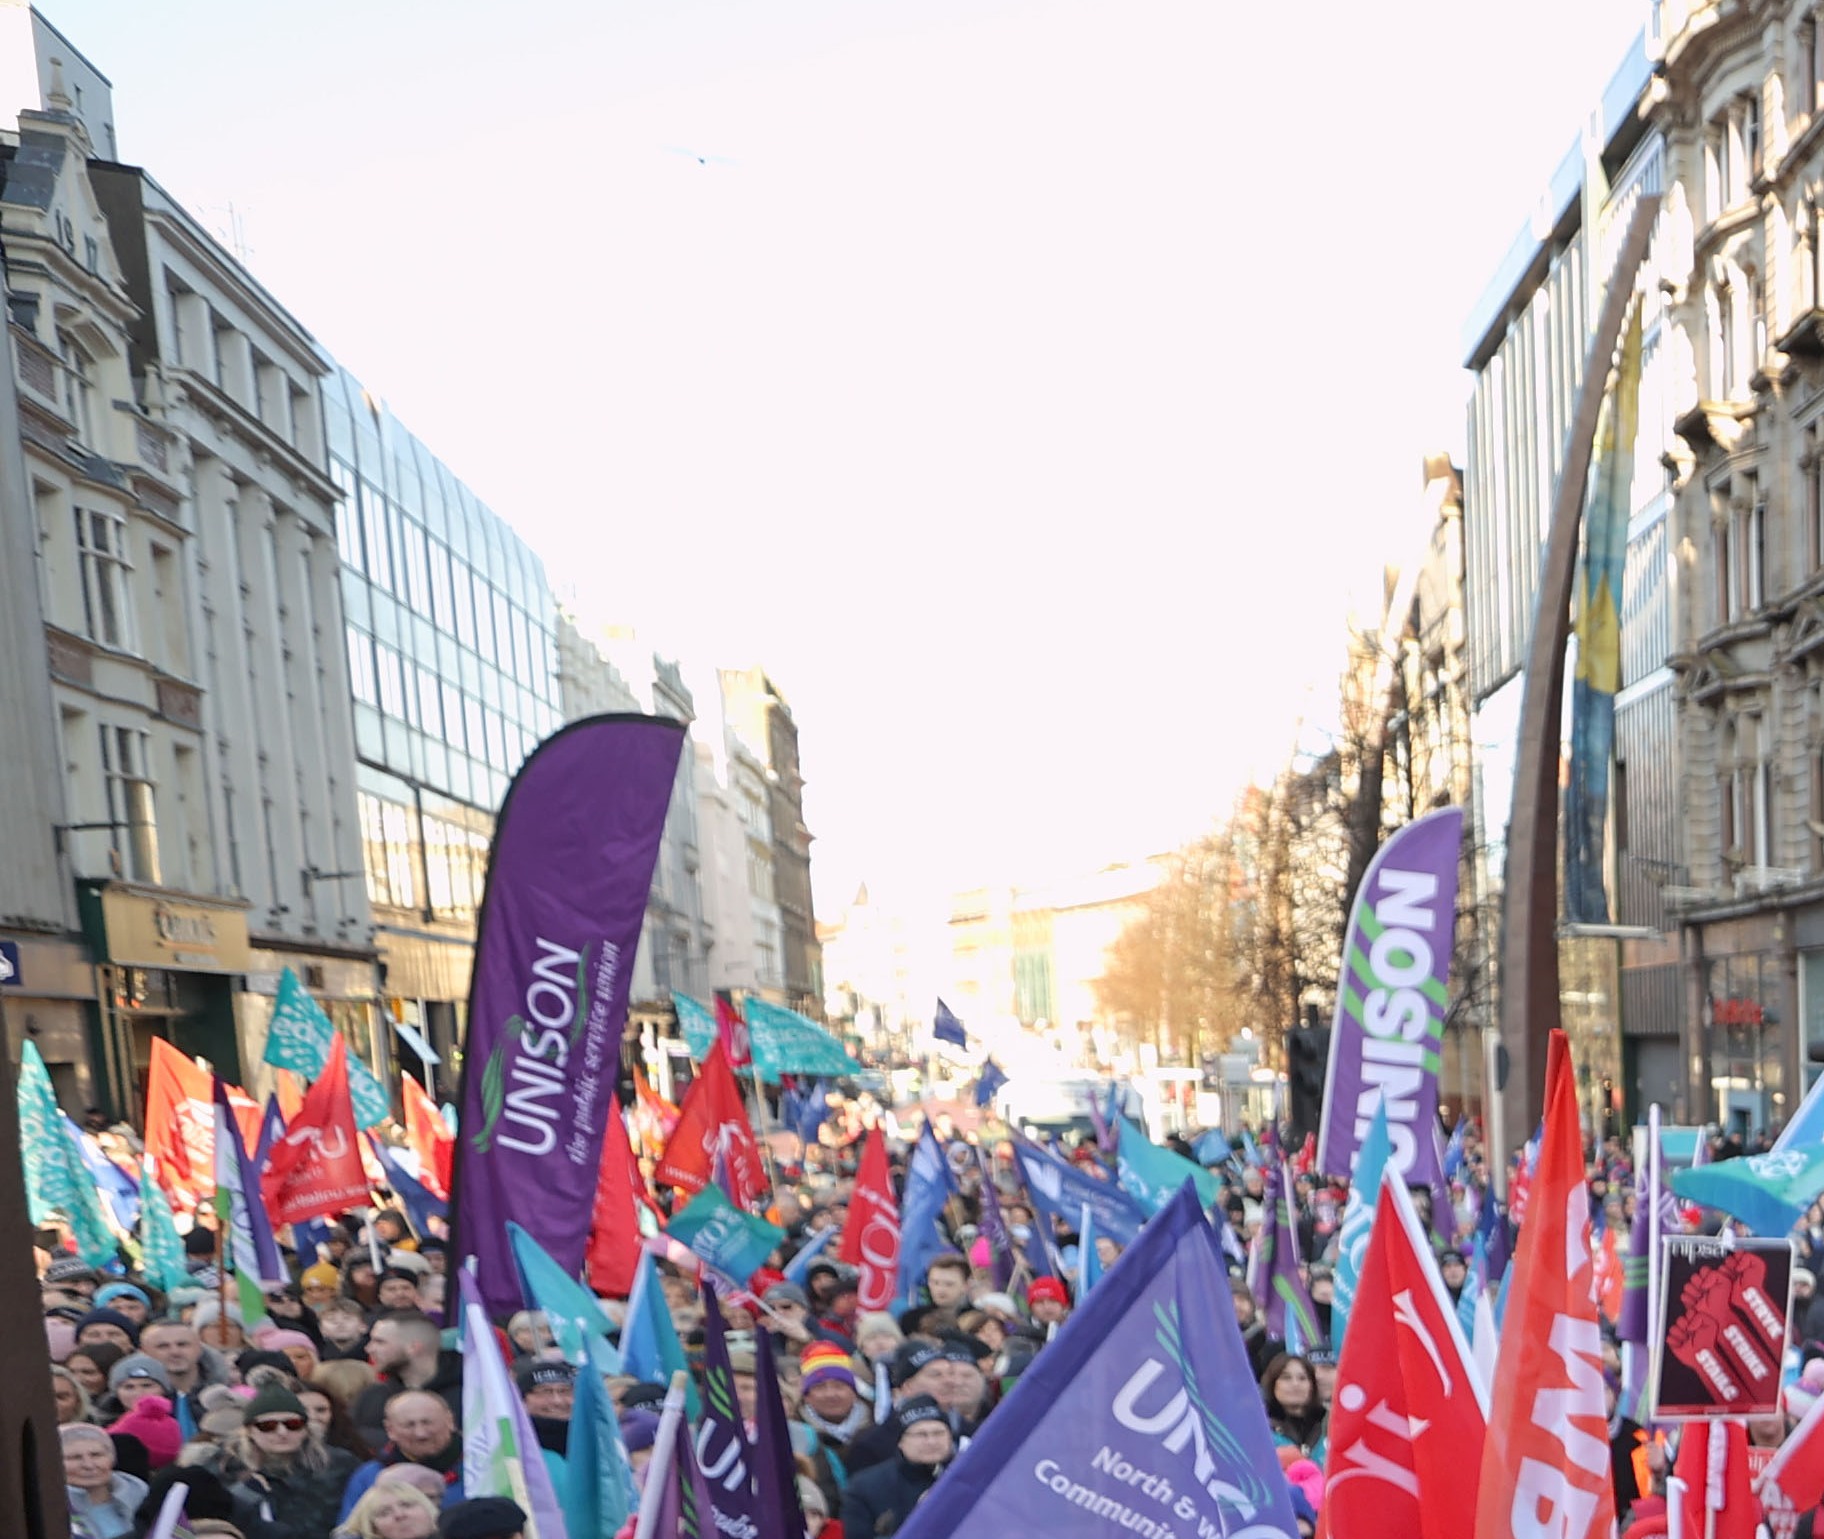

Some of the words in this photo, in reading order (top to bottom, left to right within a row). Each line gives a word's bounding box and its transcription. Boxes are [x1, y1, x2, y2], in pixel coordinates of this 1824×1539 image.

[496, 936, 581, 1156] UNISON
[1091, 1446, 1174, 1504] North
[1173, 1495, 1197, 1521] &
